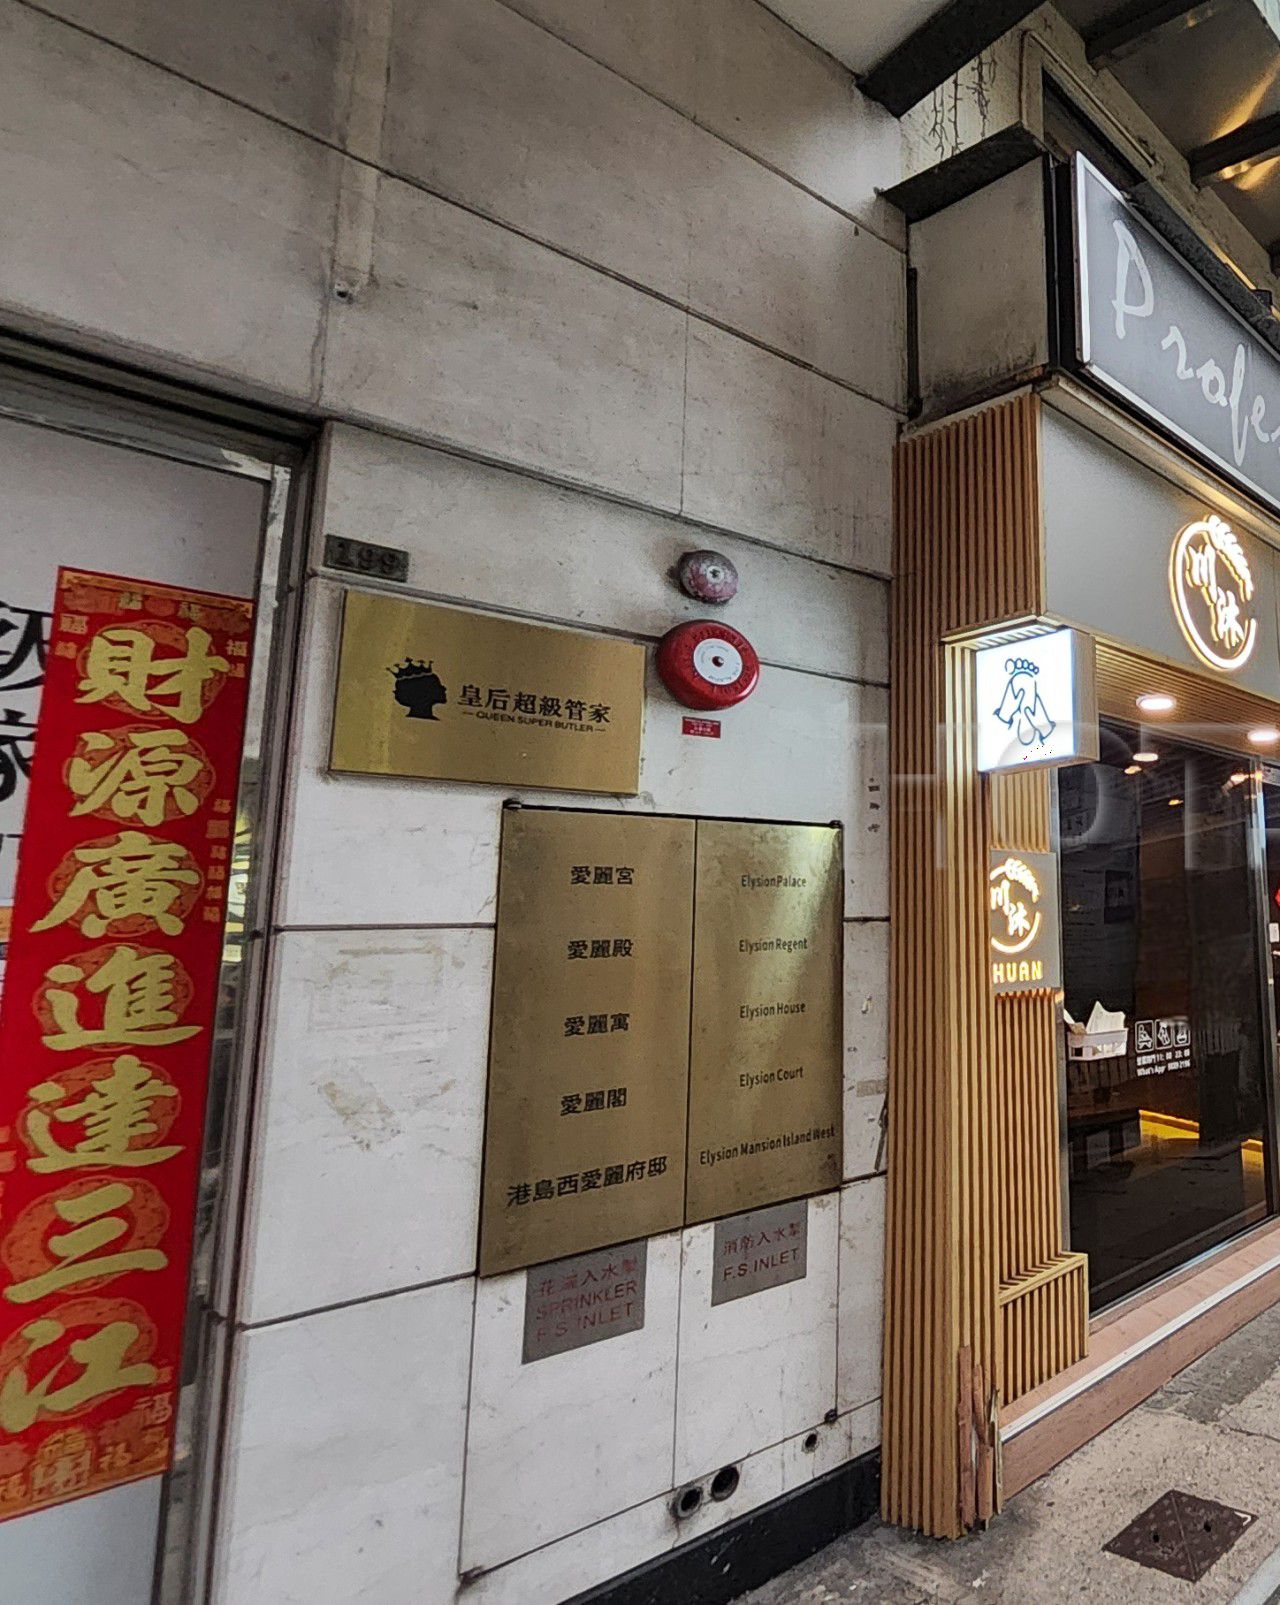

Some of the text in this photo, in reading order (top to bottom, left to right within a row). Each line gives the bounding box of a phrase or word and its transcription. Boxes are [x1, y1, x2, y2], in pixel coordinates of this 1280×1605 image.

[457, 684, 611, 723] 皇后超級管家
[476, 710, 594, 733] QUEEN SUPER BUTLER
[570, 865, 635, 886] 愛麗宮
[741, 874, 807, 888] Elysion Palace
[567, 938, 634, 960] 愛麗殿
[739, 937, 808, 955] Elysion Regent
[993, 960, 1043, 983] HUAN
[739, 1002, 806, 1021] Elysion House
[1, 626, 230, 1433] 財源廣進達三江
[564, 1012, 631, 1037] 愛麗寓
[739, 1065, 804, 1089] Elysion Court
[560, 1087, 628, 1117] 愛麗閣
[699, 1147, 738, 1167] Elysion
[740, 1137, 782, 1156] Mansion
[782, 1128, 812, 1148] Island
[506, 1155, 667, 1209] 港島西愛麗府邸
[535, 1280, 638, 1321] SPRINKLER
[577, 1301, 633, 1330] INLET
